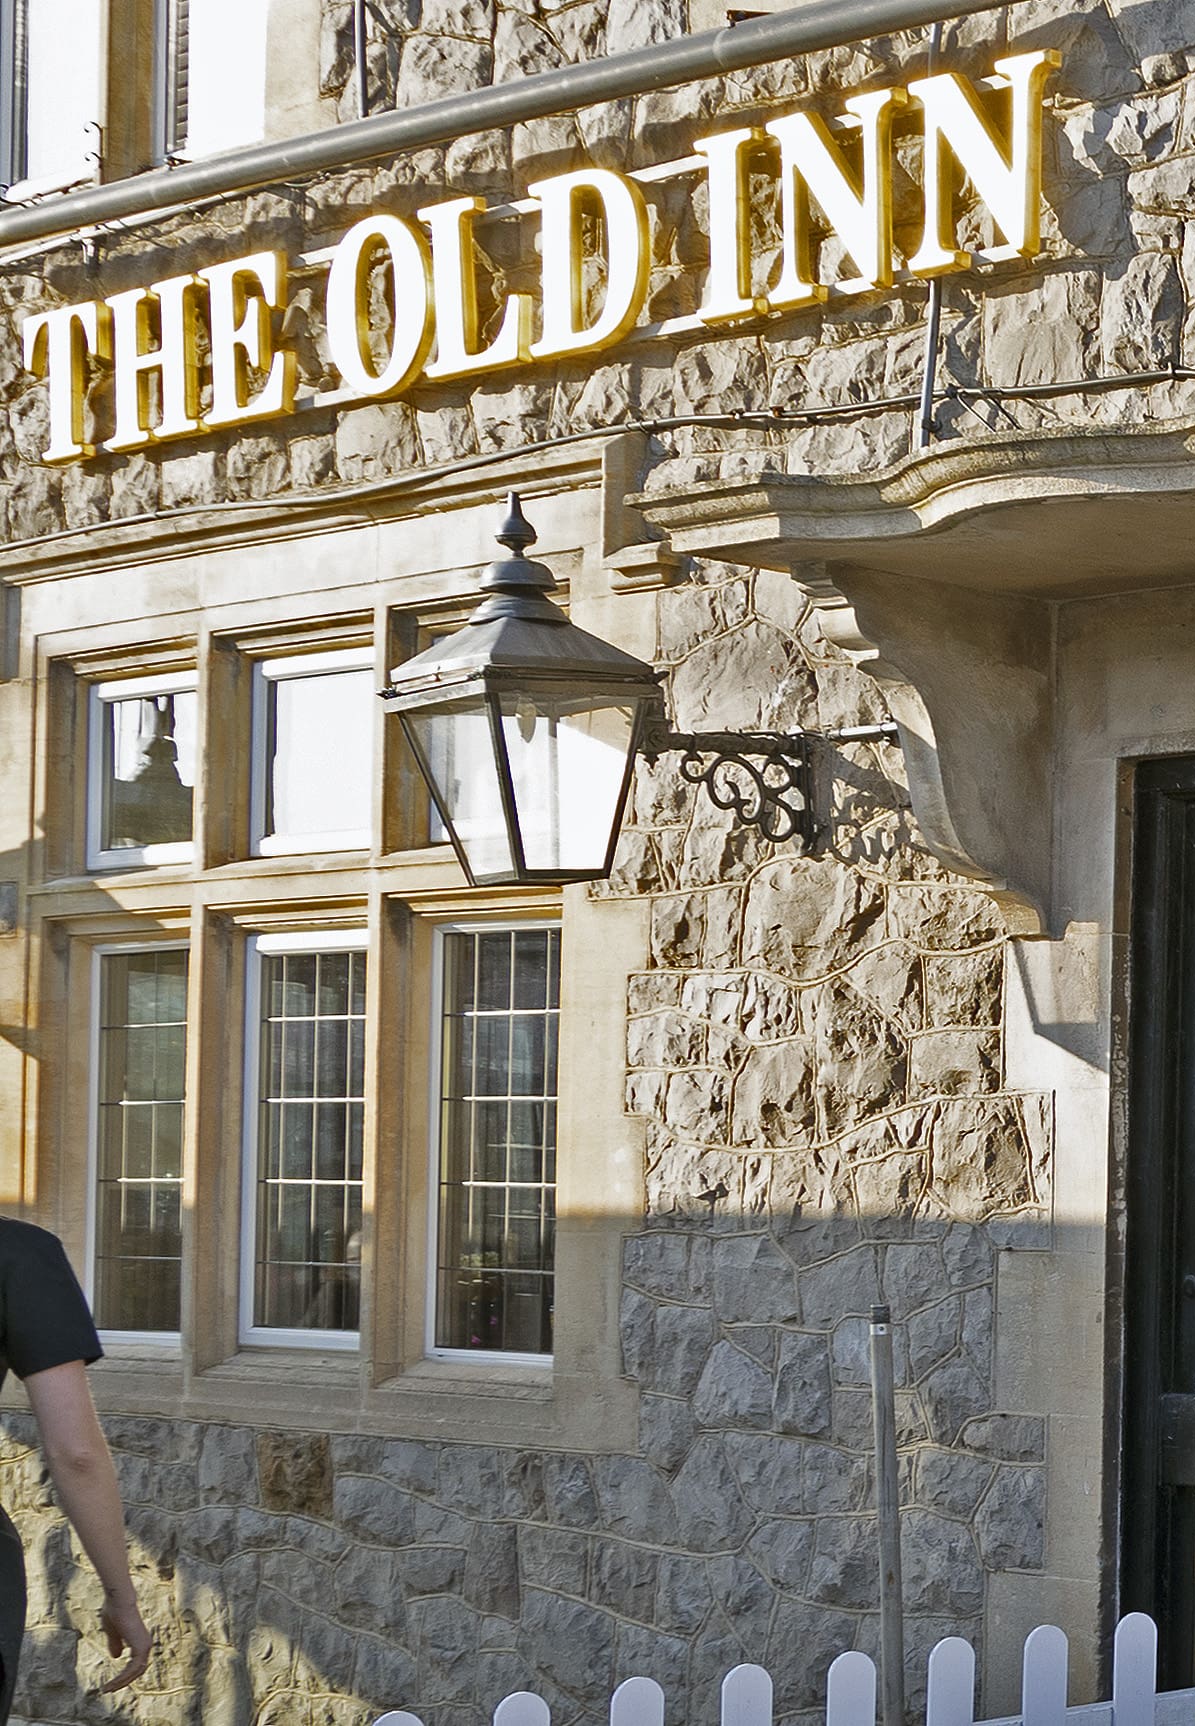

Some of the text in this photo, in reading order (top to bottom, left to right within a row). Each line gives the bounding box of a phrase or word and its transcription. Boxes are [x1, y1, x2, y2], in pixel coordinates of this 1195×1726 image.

[23, 48, 1061, 463] THE OLD INN
